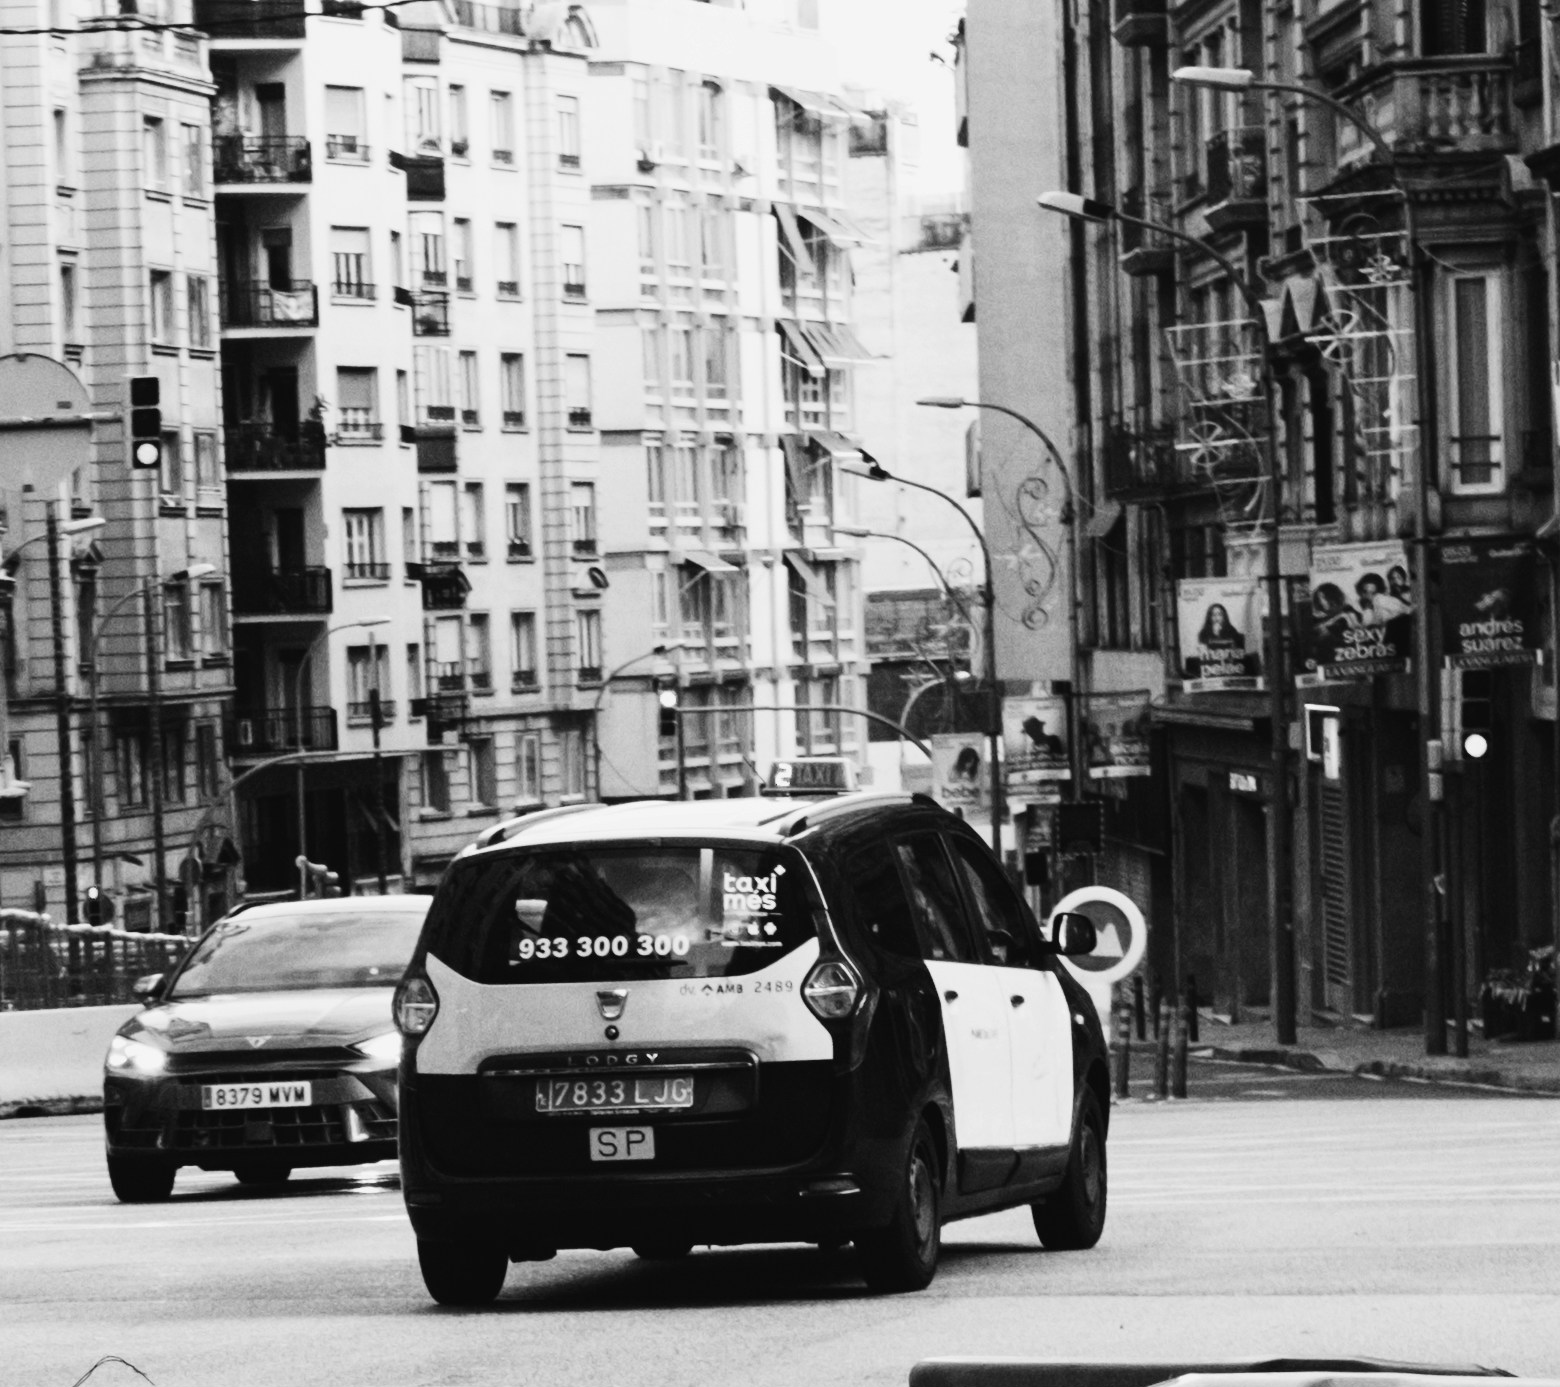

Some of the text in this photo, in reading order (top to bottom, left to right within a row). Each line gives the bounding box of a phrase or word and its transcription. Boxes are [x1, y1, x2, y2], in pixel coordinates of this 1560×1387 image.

[723, 871, 777, 893] taxi
[722, 888, 778, 910] més
[518, 934, 690, 960] 933 300 300
[716, 982, 744, 995] AMB
[754, 980, 794, 993] 2489
[567, 1053, 659, 1067] LODGY
[216, 1085, 306, 1107] 8379 MVM
[554, 1077, 688, 1107] 7833 LJG
[597, 1129, 646, 1158] SP
